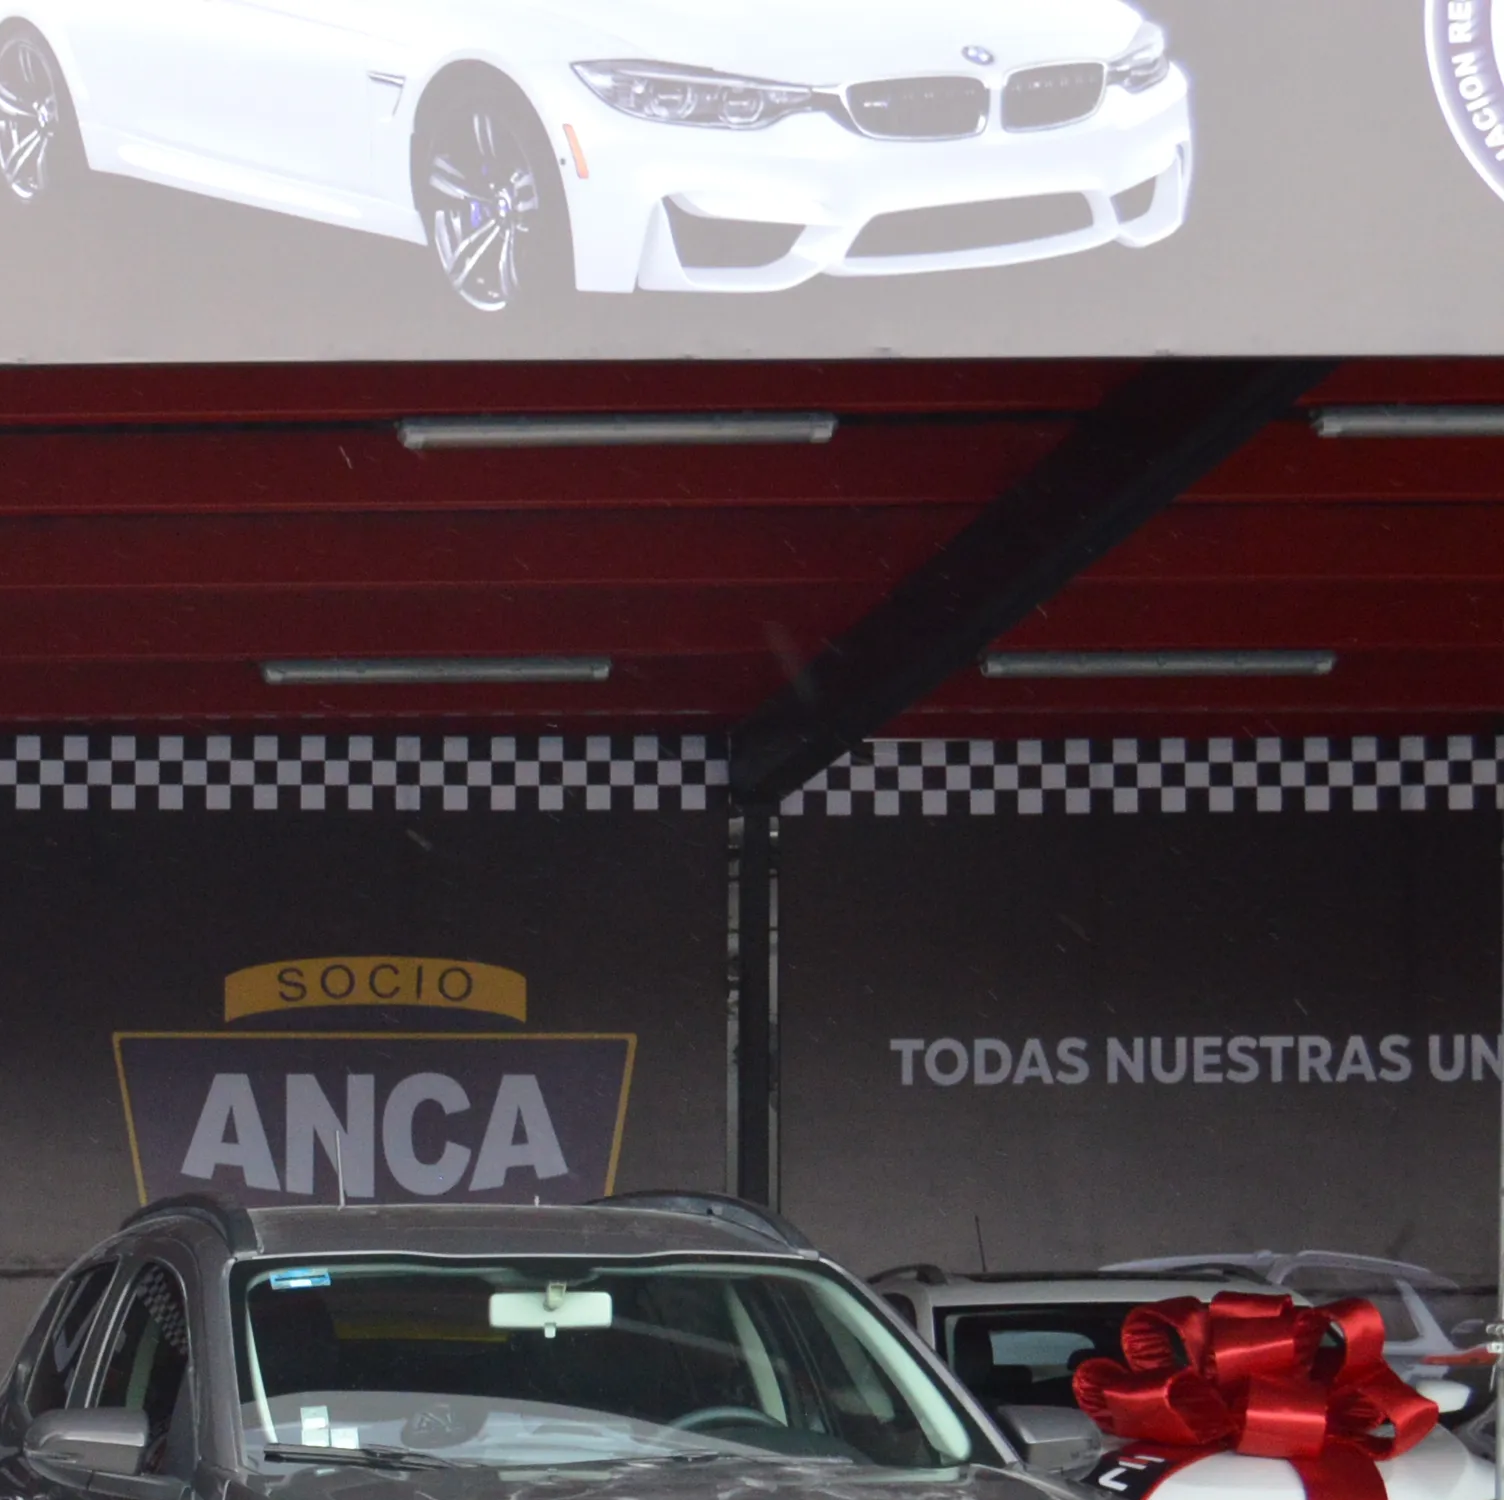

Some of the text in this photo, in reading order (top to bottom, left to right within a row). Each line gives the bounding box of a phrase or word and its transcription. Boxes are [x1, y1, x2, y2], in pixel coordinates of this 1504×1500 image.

[276, 963, 475, 1003] SOCIO
[889, 1037, 1090, 1086] TODAS
[1106, 1034, 1413, 1084] NUESTRAS
[179, 1072, 570, 1199] ANCA
